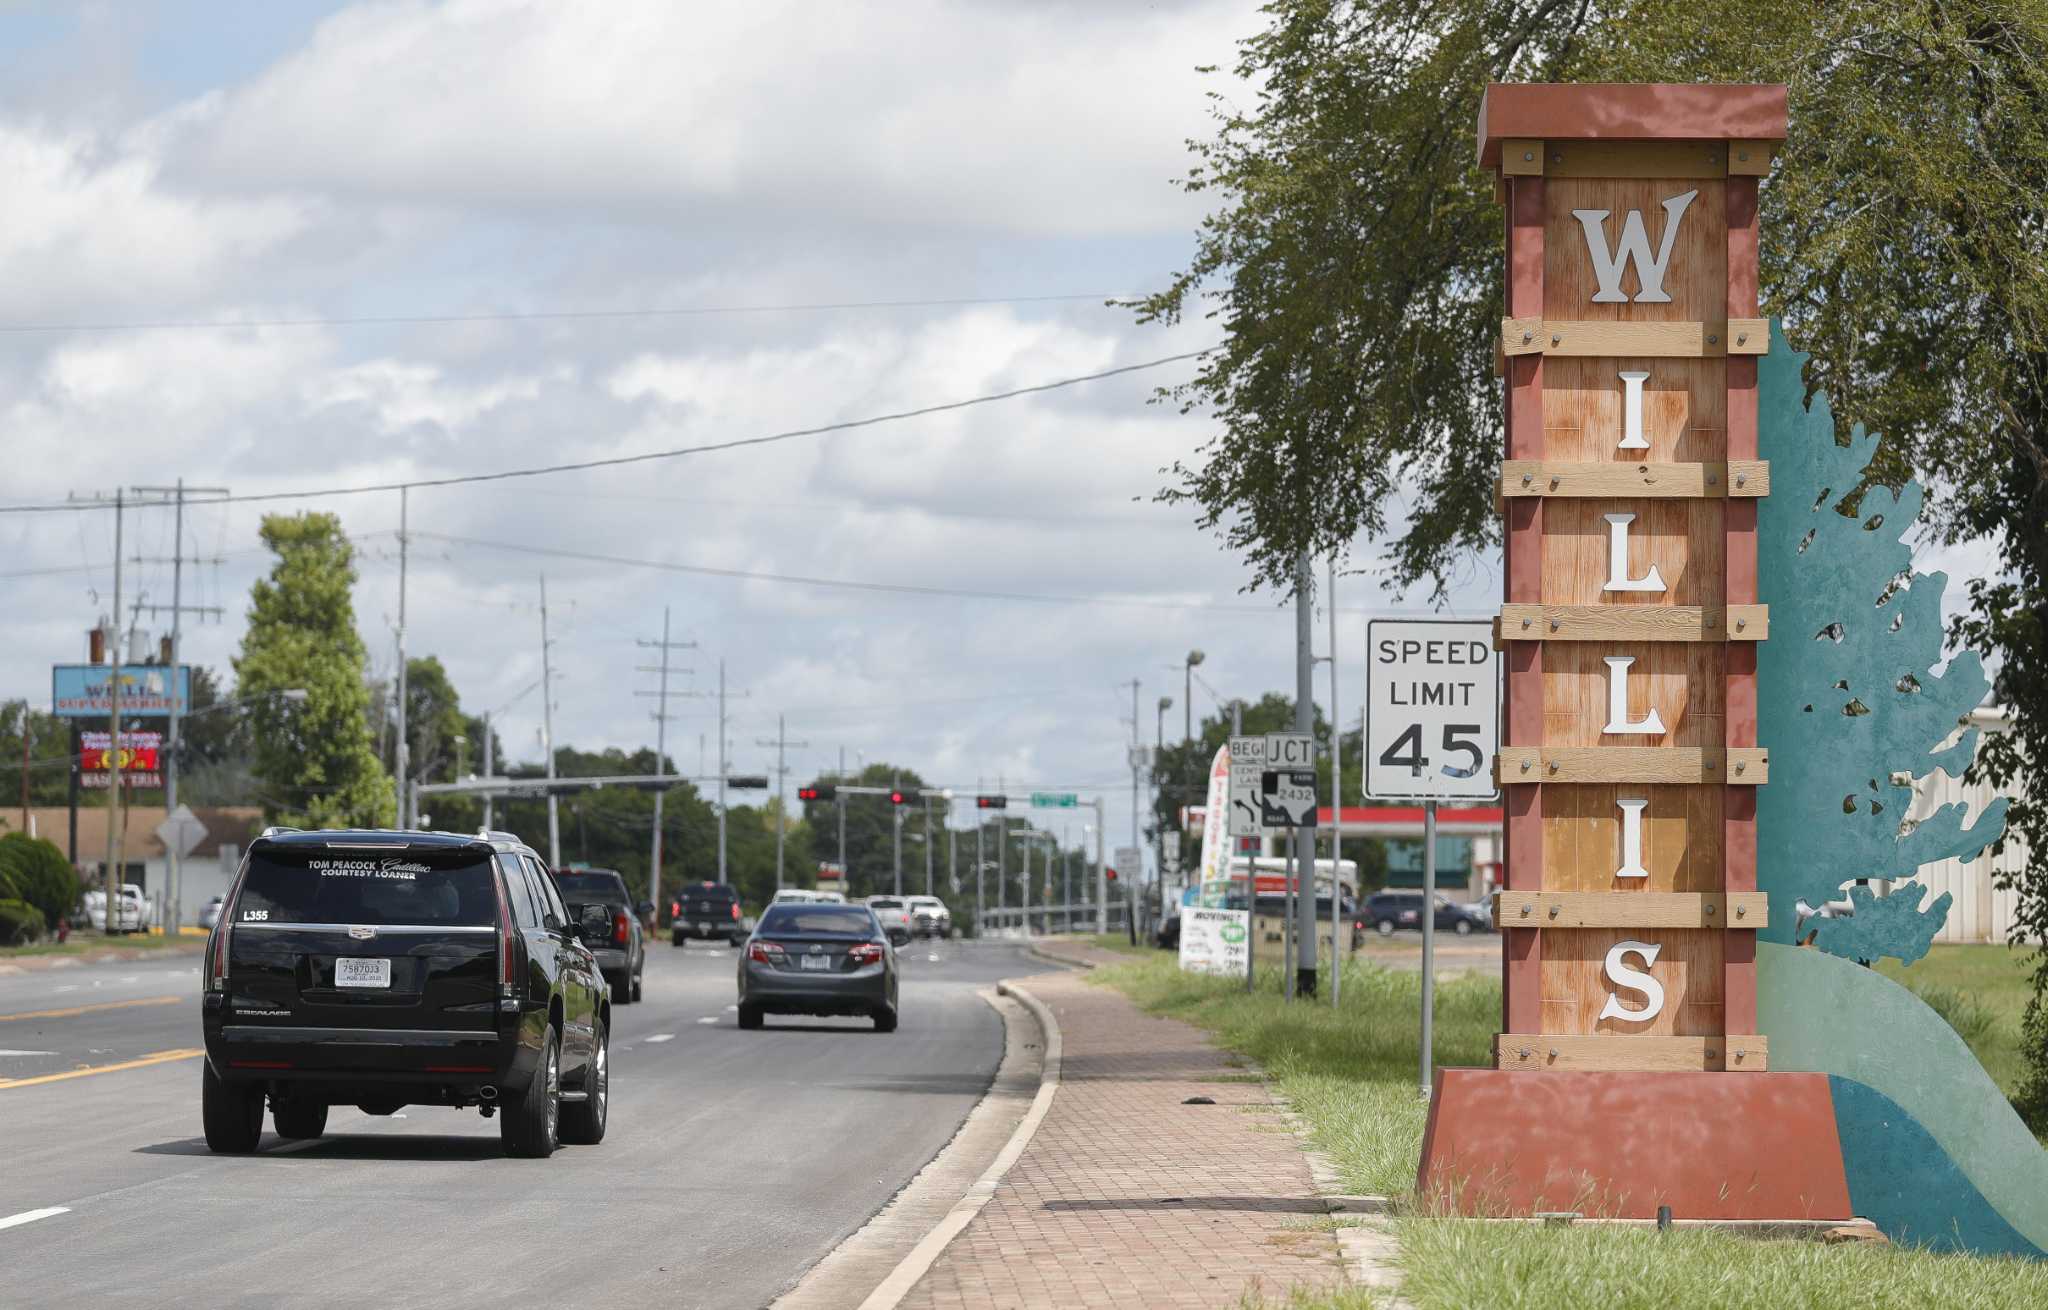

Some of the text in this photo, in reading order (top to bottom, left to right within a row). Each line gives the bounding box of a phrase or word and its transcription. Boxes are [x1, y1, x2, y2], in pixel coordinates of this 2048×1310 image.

[1571, 189, 1698, 1022] WILLIS
[1378, 639, 1490, 665] SPEED
[1390, 681, 1476, 706] LIMIT
[1232, 741, 1265, 756] BEGI
[1269, 739, 1311, 763] JCT
[1379, 723, 1484, 779] 45
[1234, 767, 1263, 775] CENT
[1239, 775, 1262, 785] LAN
[1279, 789, 1312, 801] 2432
[308, 857, 432, 873] TOM PEACOCK Cadillac
[321, 868, 416, 880] COURTESY LOANER
[243, 910, 269, 921] L355
